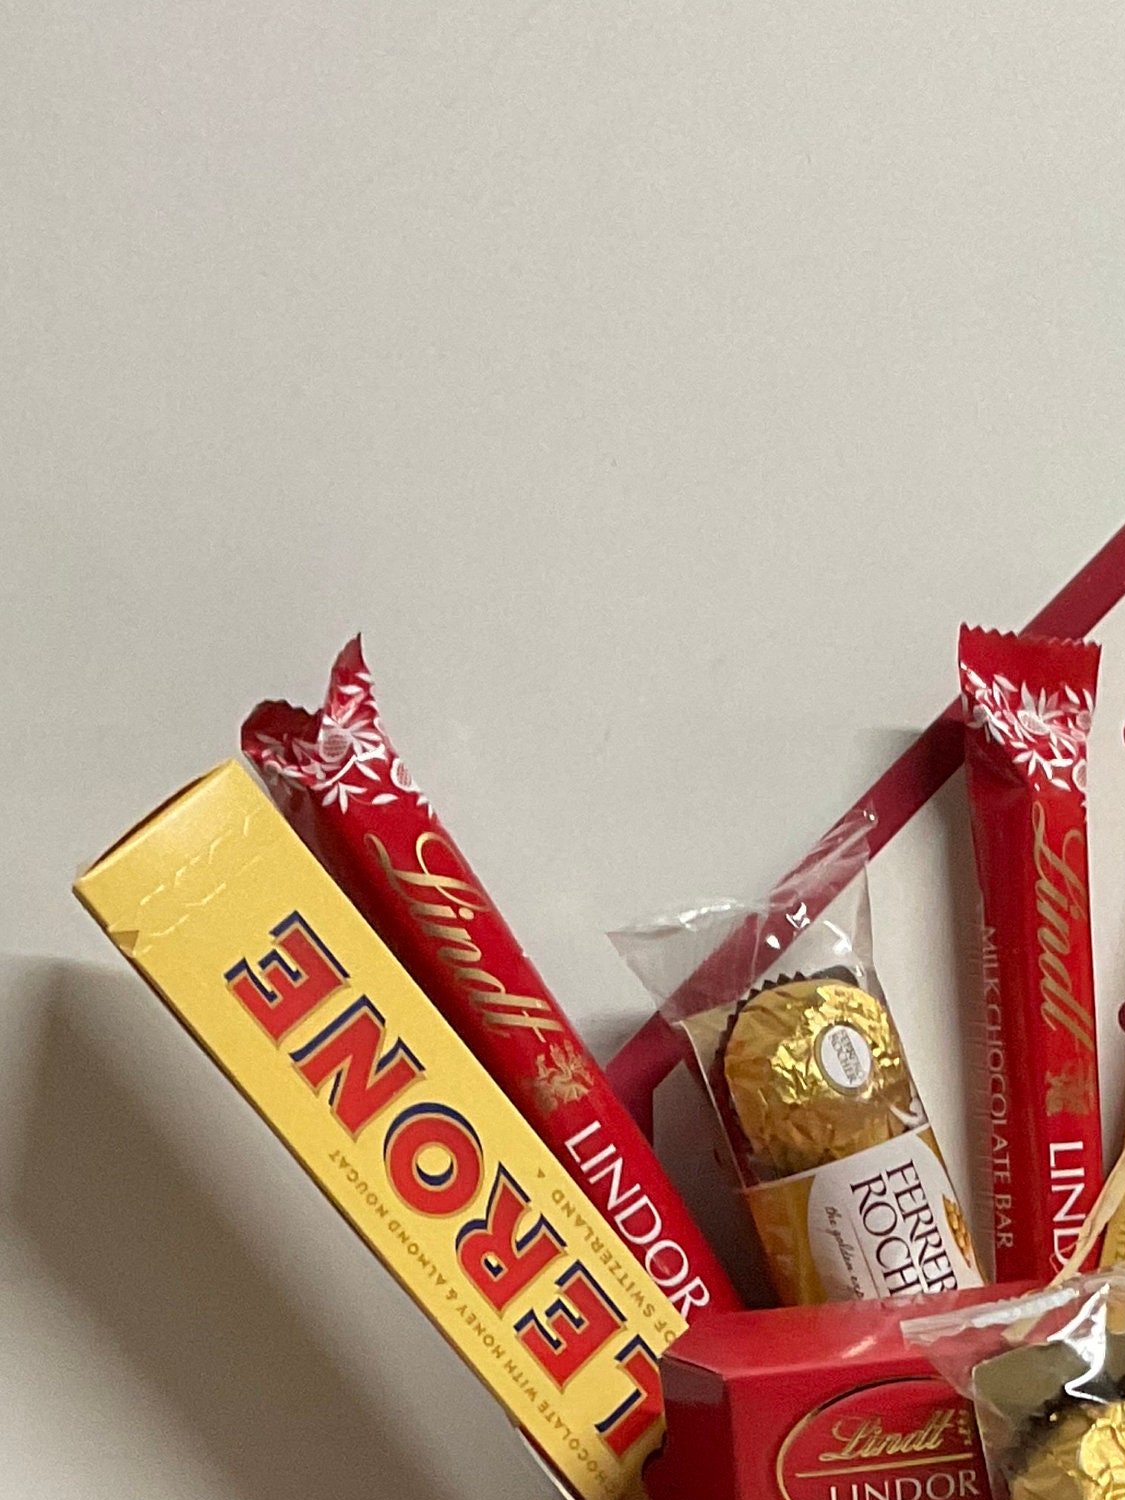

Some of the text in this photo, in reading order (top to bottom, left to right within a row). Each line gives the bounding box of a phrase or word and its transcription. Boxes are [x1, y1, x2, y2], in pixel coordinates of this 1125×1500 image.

[364, 832, 563, 1042] Lindt
[1032, 802, 1093, 1052] Lindt
[982, 926, 998, 998] MILK
[995, 1194, 1013, 1249] BAR
[329, 1150, 389, 1218] NOUGAT
[564, 1120, 710, 1319] LINDOR
[388, 1219, 447, 1286] ALMOND
[551, 1189, 656, 1318] SWITZERLAND
[850, 1173, 922, 1297] ROCH
[446, 1287, 458, 1300] &
[455, 1304, 502, 1359] HONEY
[503, 1358, 539, 1402] WITH
[819, 1409, 955, 1461] Lindt
